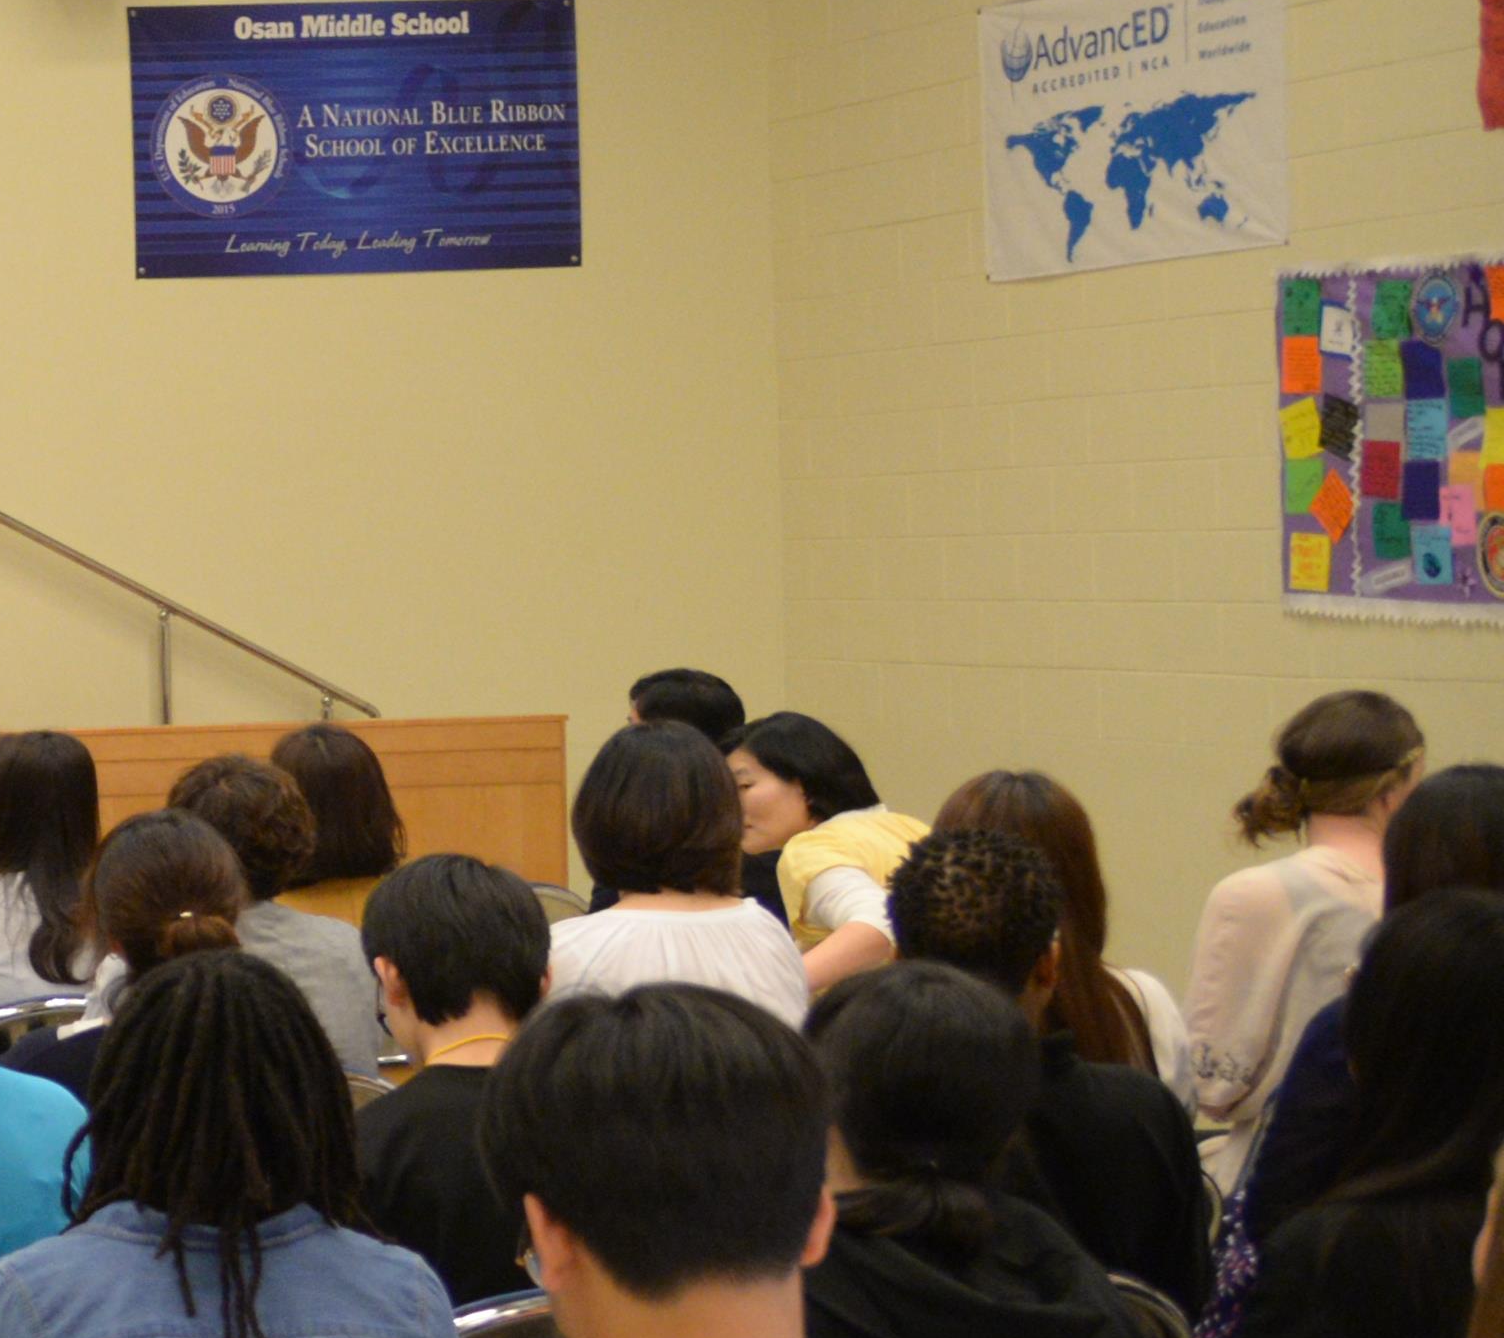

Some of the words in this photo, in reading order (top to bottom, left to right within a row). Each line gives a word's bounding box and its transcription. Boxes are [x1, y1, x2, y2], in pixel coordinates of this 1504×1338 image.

[234, 16, 294, 40] Osan
[300, 14, 386, 38] Middle
[391, 11, 470, 36] School
[1033, 6, 1170, 71] AdvancED
[1032, 65, 1120, 94] ACCREDITED
[1140, 54, 1170, 72] NCA
[297, 105, 315, 128] A
[322, 104, 424, 128] NATIONAL
[431, 101, 483, 125] BLUE
[490, 99, 566, 123] RIBBON
[305, 134, 386, 158] SCHOOL
[392, 138, 417, 155] OF
[425, 131, 546, 155] EXCELLENCE
[212, 203, 236, 215] 2015
[225, 234, 290, 257] Learning
[356, 230, 416, 253] Leading
[423, 228, 492, 248] Tomorrow
